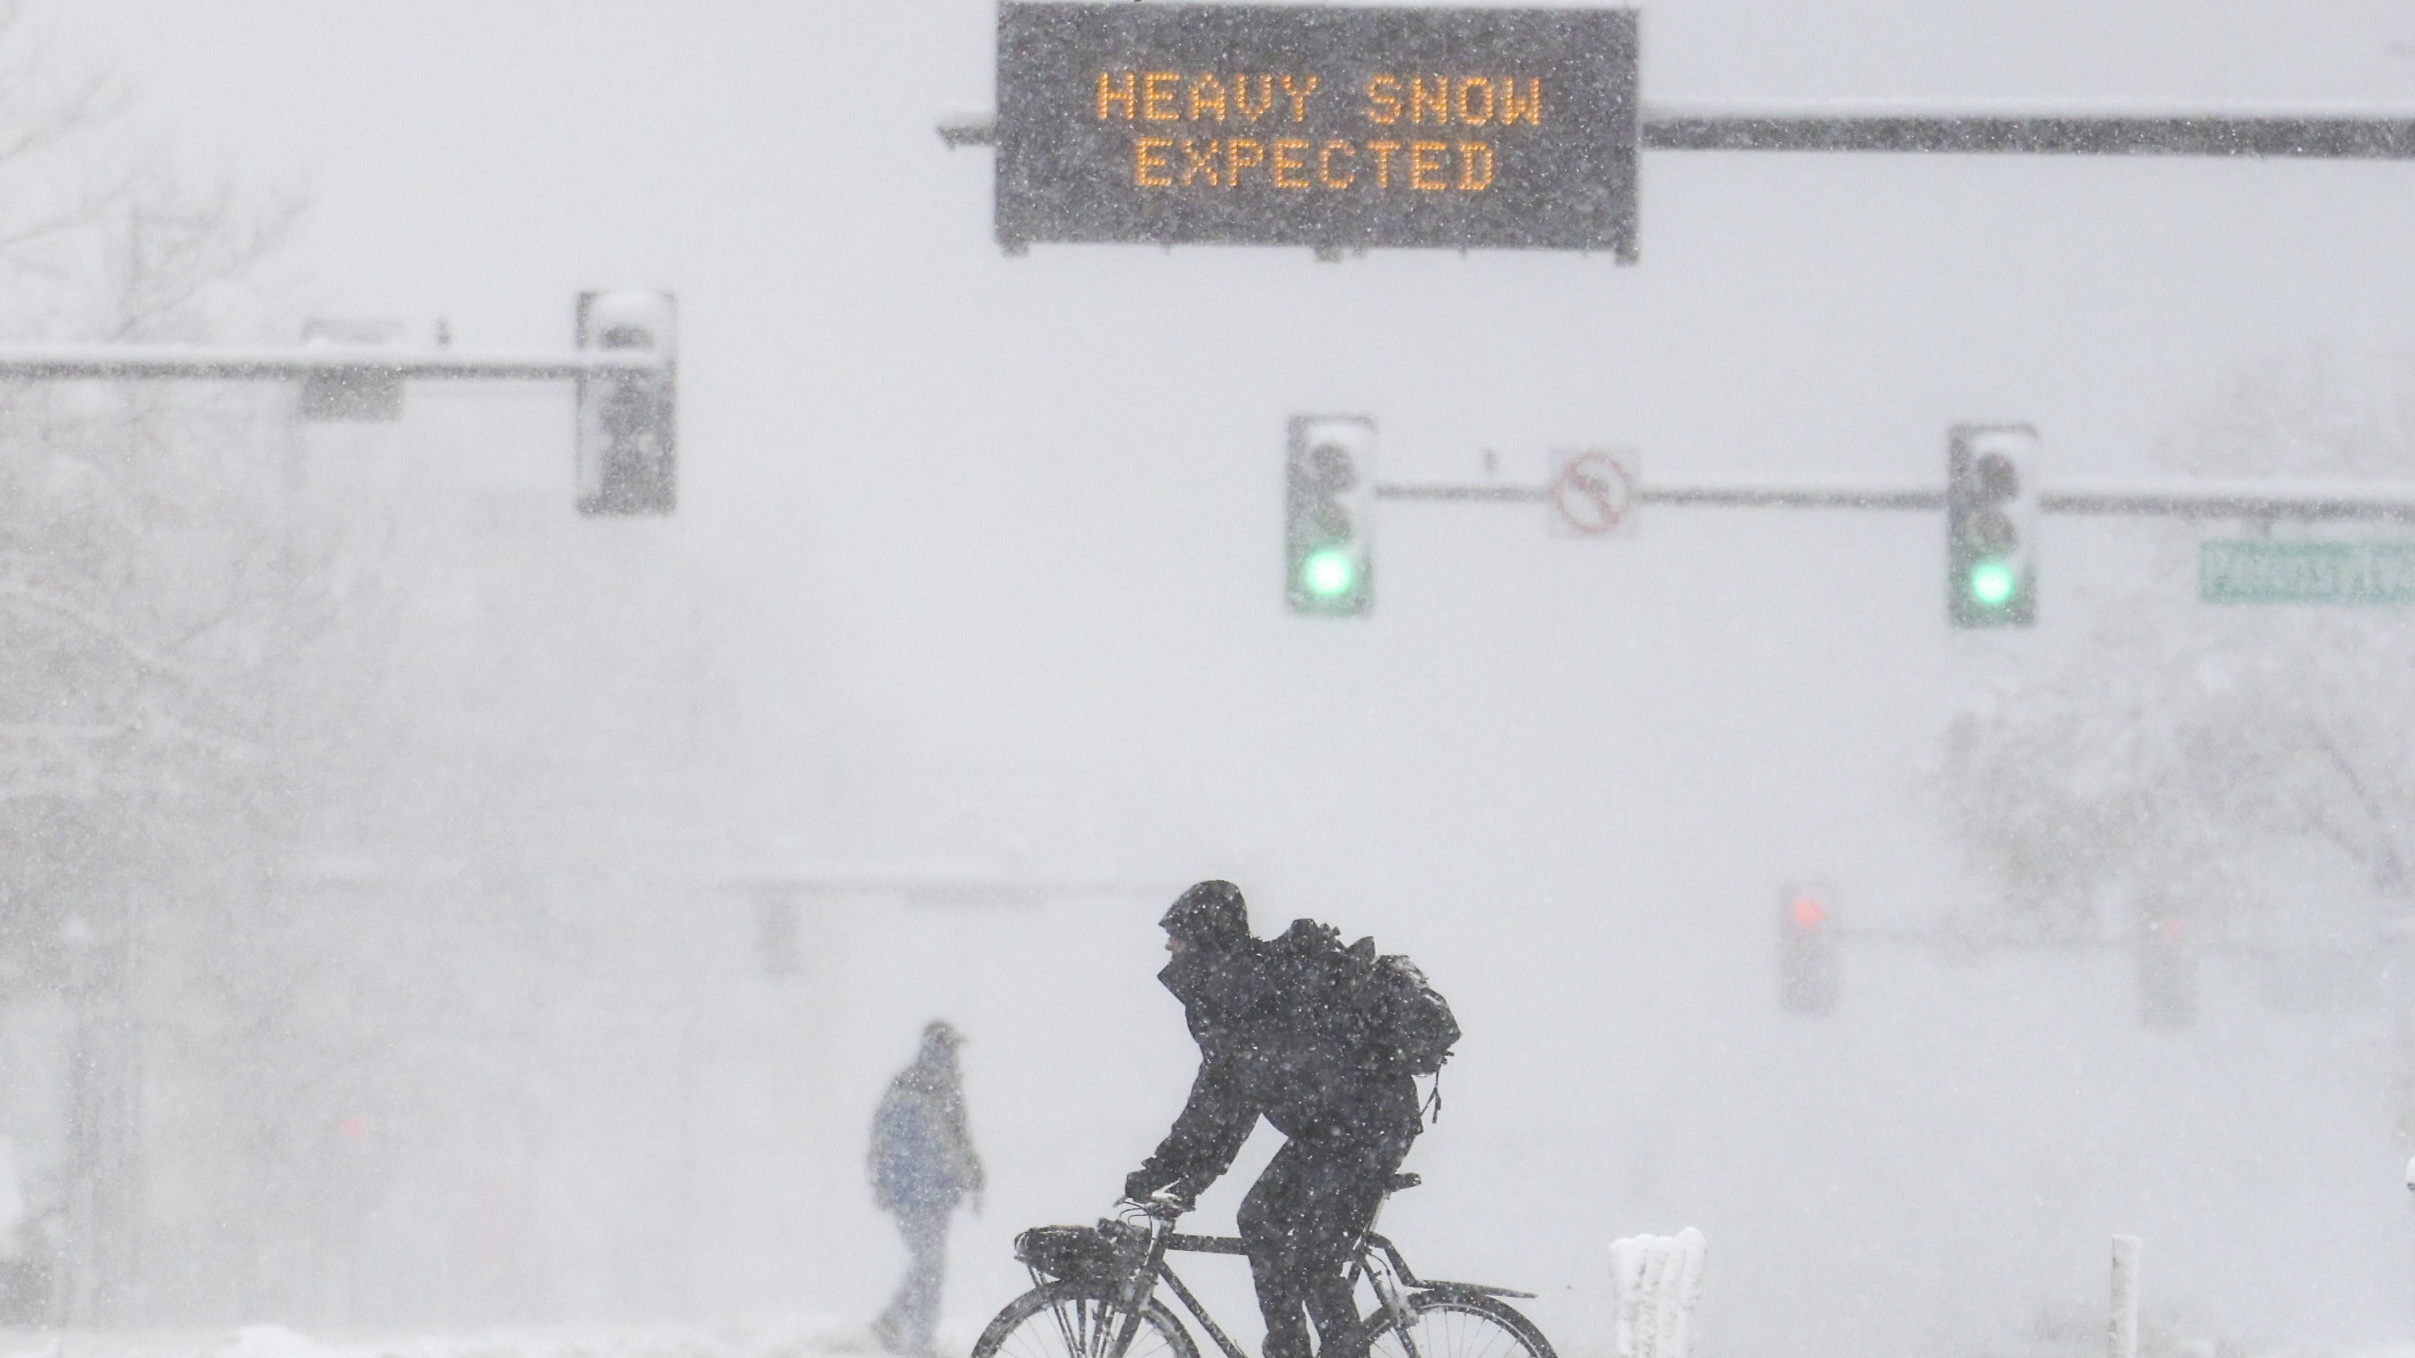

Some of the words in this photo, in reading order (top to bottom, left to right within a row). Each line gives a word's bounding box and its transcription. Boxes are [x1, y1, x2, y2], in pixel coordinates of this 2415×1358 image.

[1095, 71, 1319, 123] HEAVY
[1366, 74, 1542, 126] SNOW
[1133, 136, 1495, 192] EXPECTED
